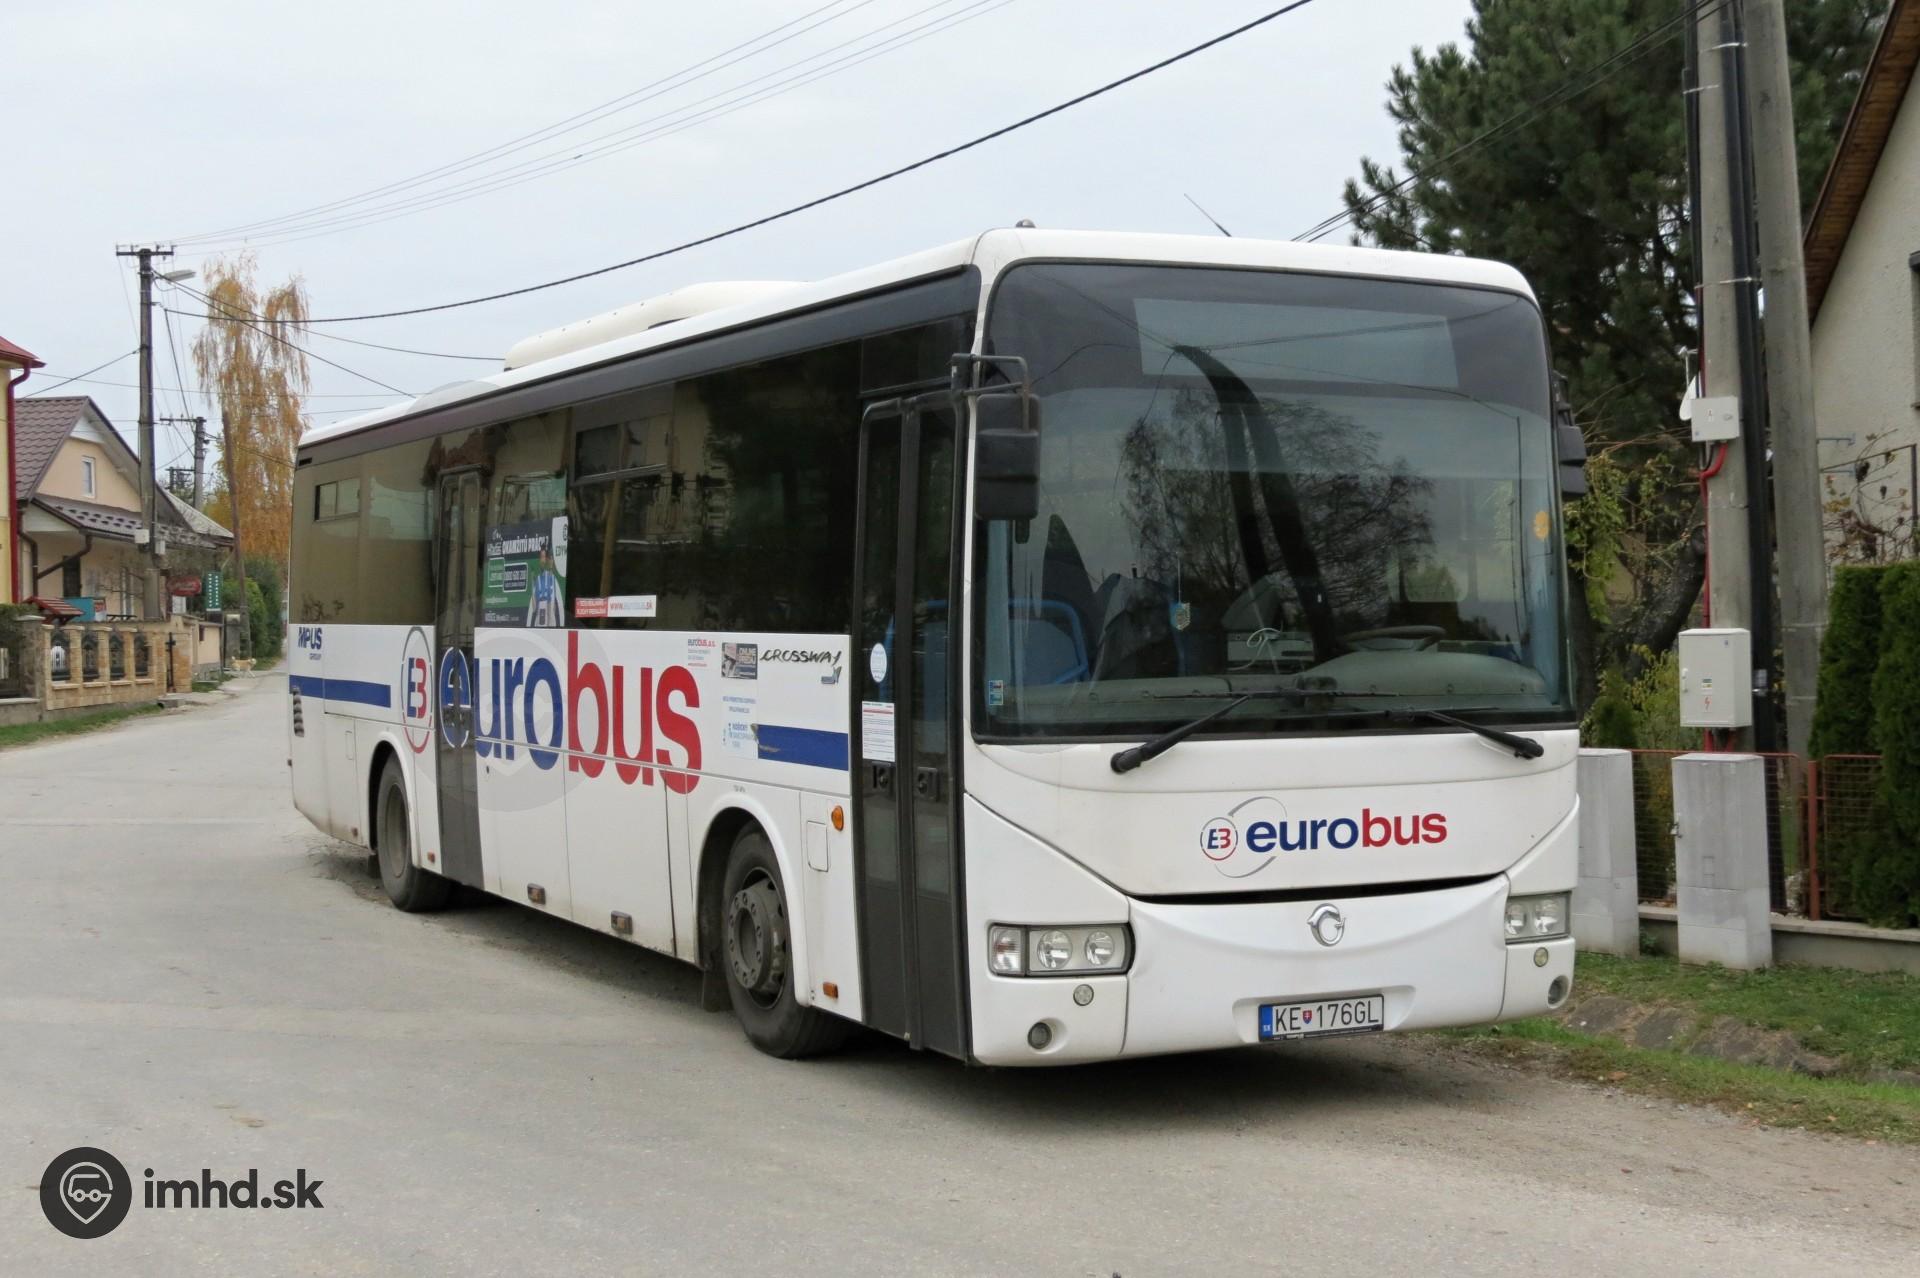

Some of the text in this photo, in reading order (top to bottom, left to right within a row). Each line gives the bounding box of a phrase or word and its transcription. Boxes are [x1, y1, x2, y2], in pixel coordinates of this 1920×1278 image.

[759, 648, 843, 668] CROSSWAY
[440, 630, 702, 795] eurobus
[1246, 808, 1448, 853] eurobus
[1275, 1000, 1379, 1032] KE 176GL
